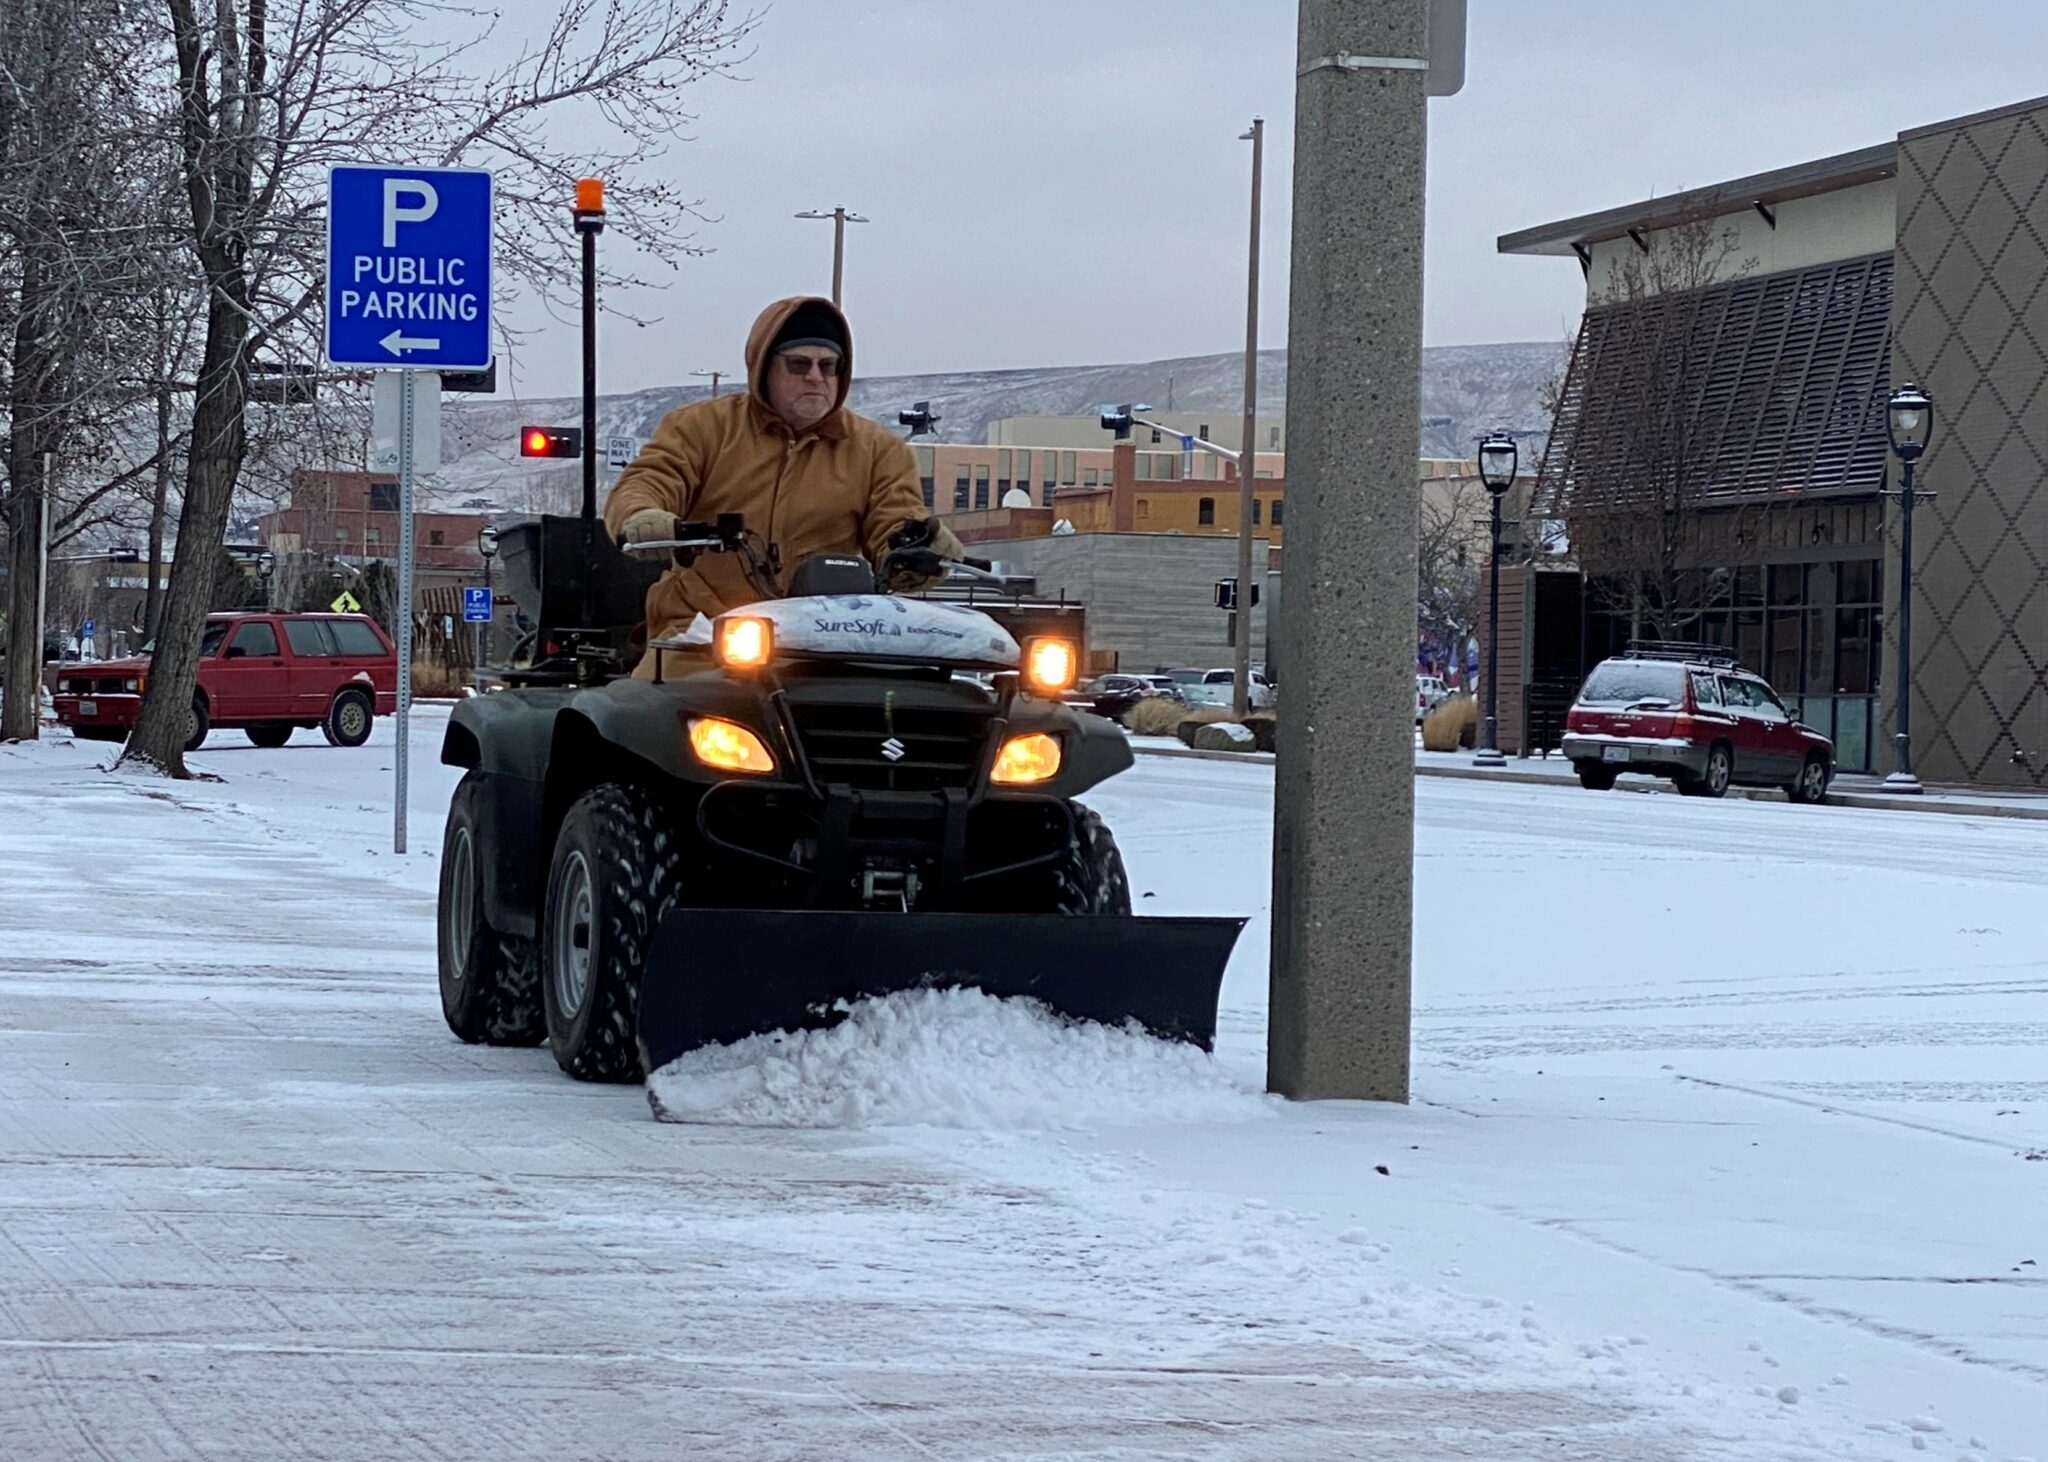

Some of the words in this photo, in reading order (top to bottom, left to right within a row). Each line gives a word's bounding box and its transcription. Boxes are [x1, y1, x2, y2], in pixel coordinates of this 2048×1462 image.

[383, 178, 439, 247] P
[354, 256, 465, 286] PUBLIC
[341, 290, 478, 321] PARKING
[611, 439, 631, 449] ONE
[611, 450, 631, 458] WAY
[473, 590, 484, 602] P
[814, 618, 886, 637] SureSoft
